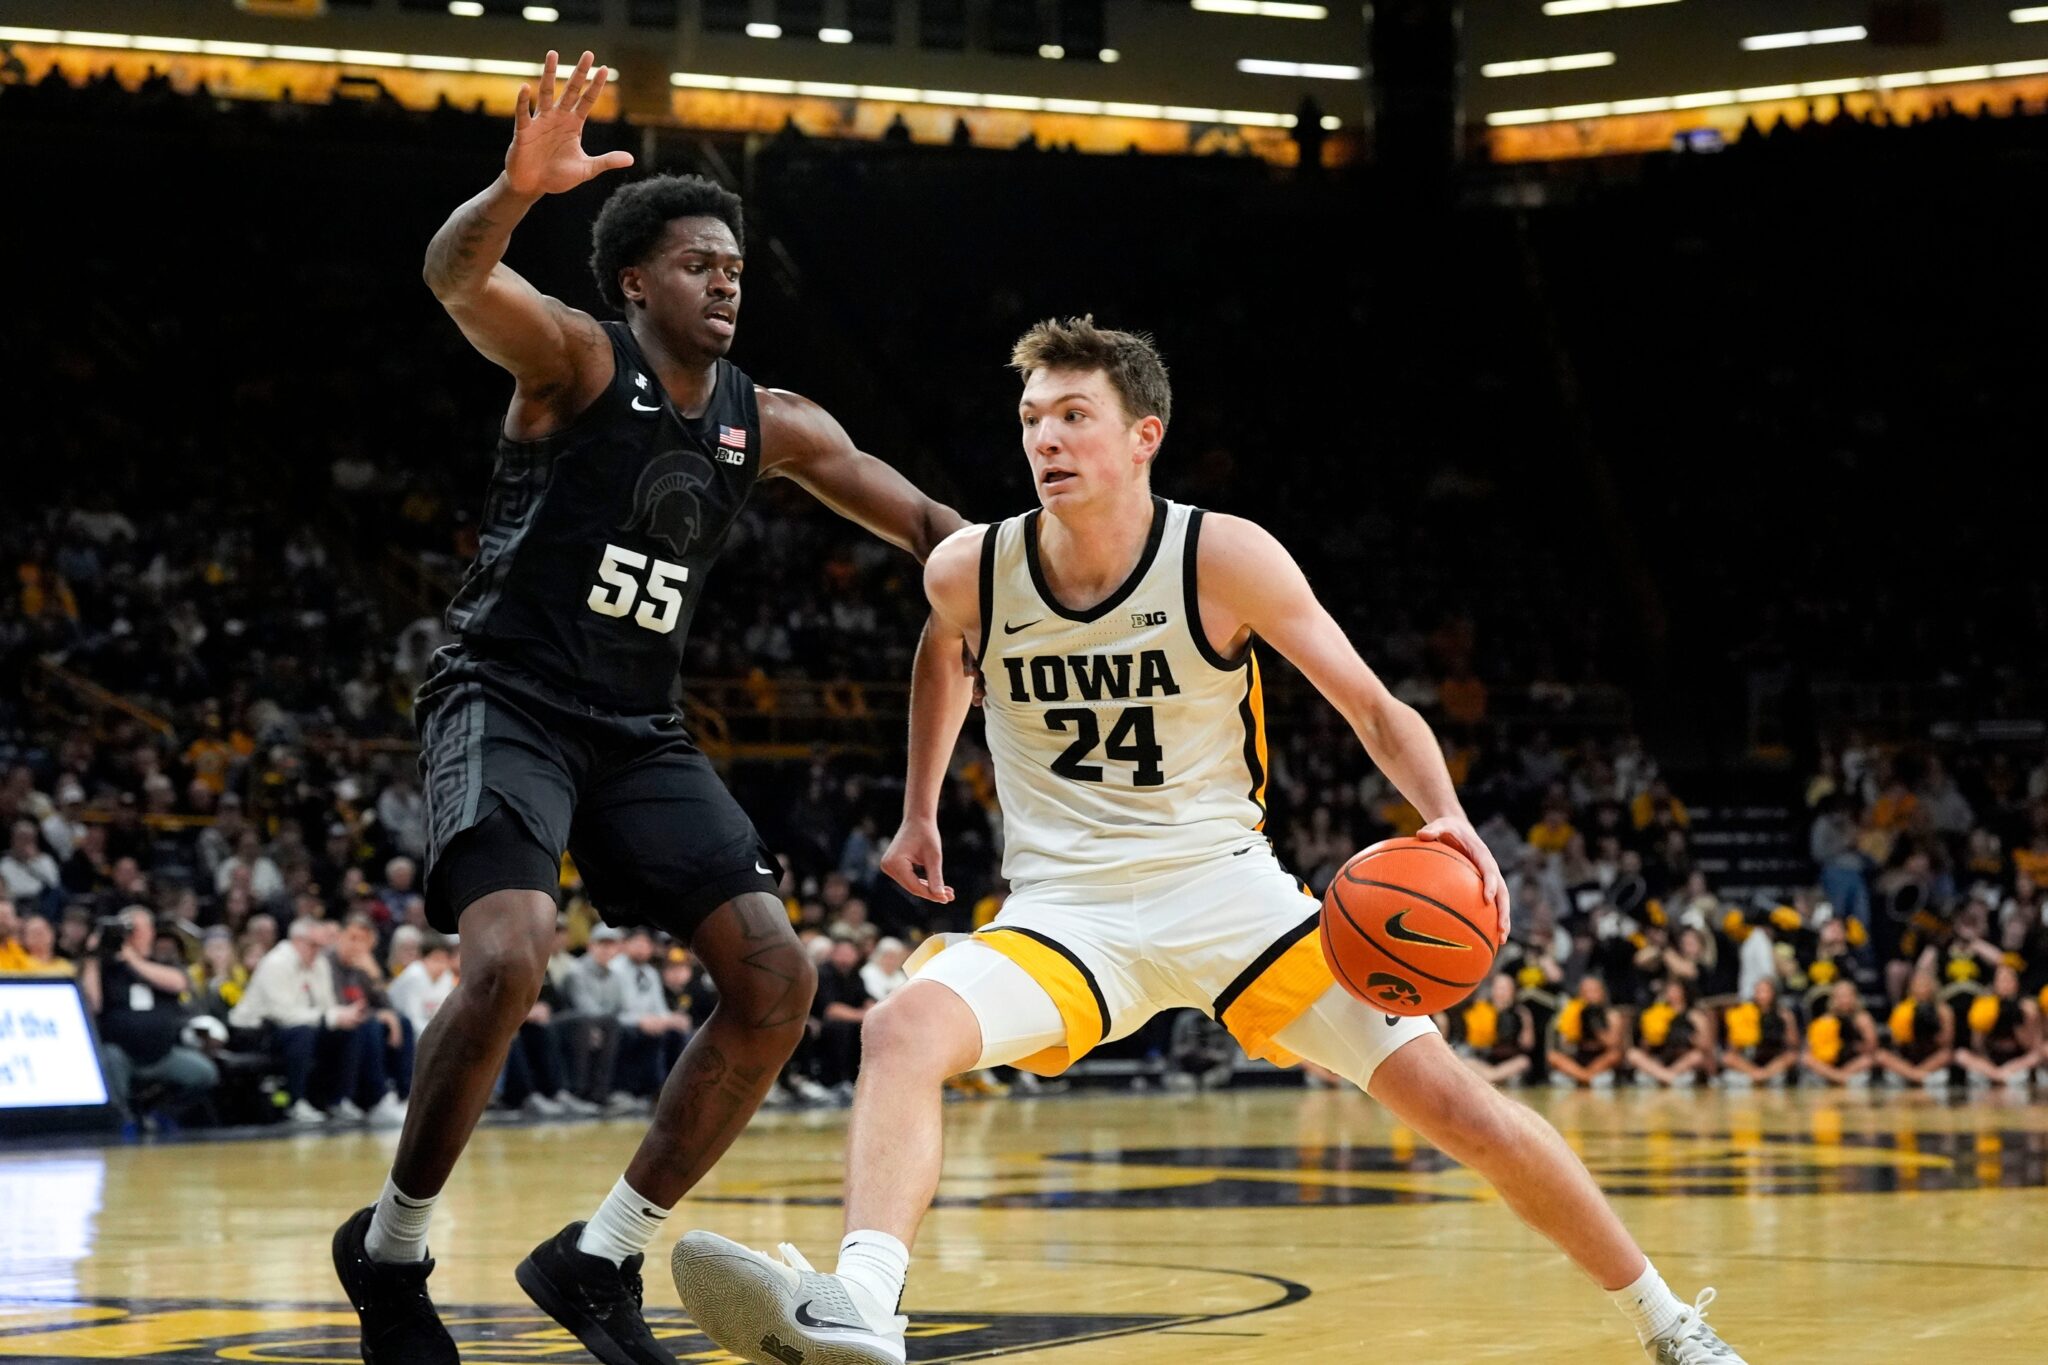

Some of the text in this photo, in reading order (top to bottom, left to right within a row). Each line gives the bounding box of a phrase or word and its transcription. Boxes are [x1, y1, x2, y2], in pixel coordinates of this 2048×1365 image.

[587, 543, 689, 634] 55
[1003, 650, 1181, 702] IOWA
[1044, 706, 1164, 786] 24
